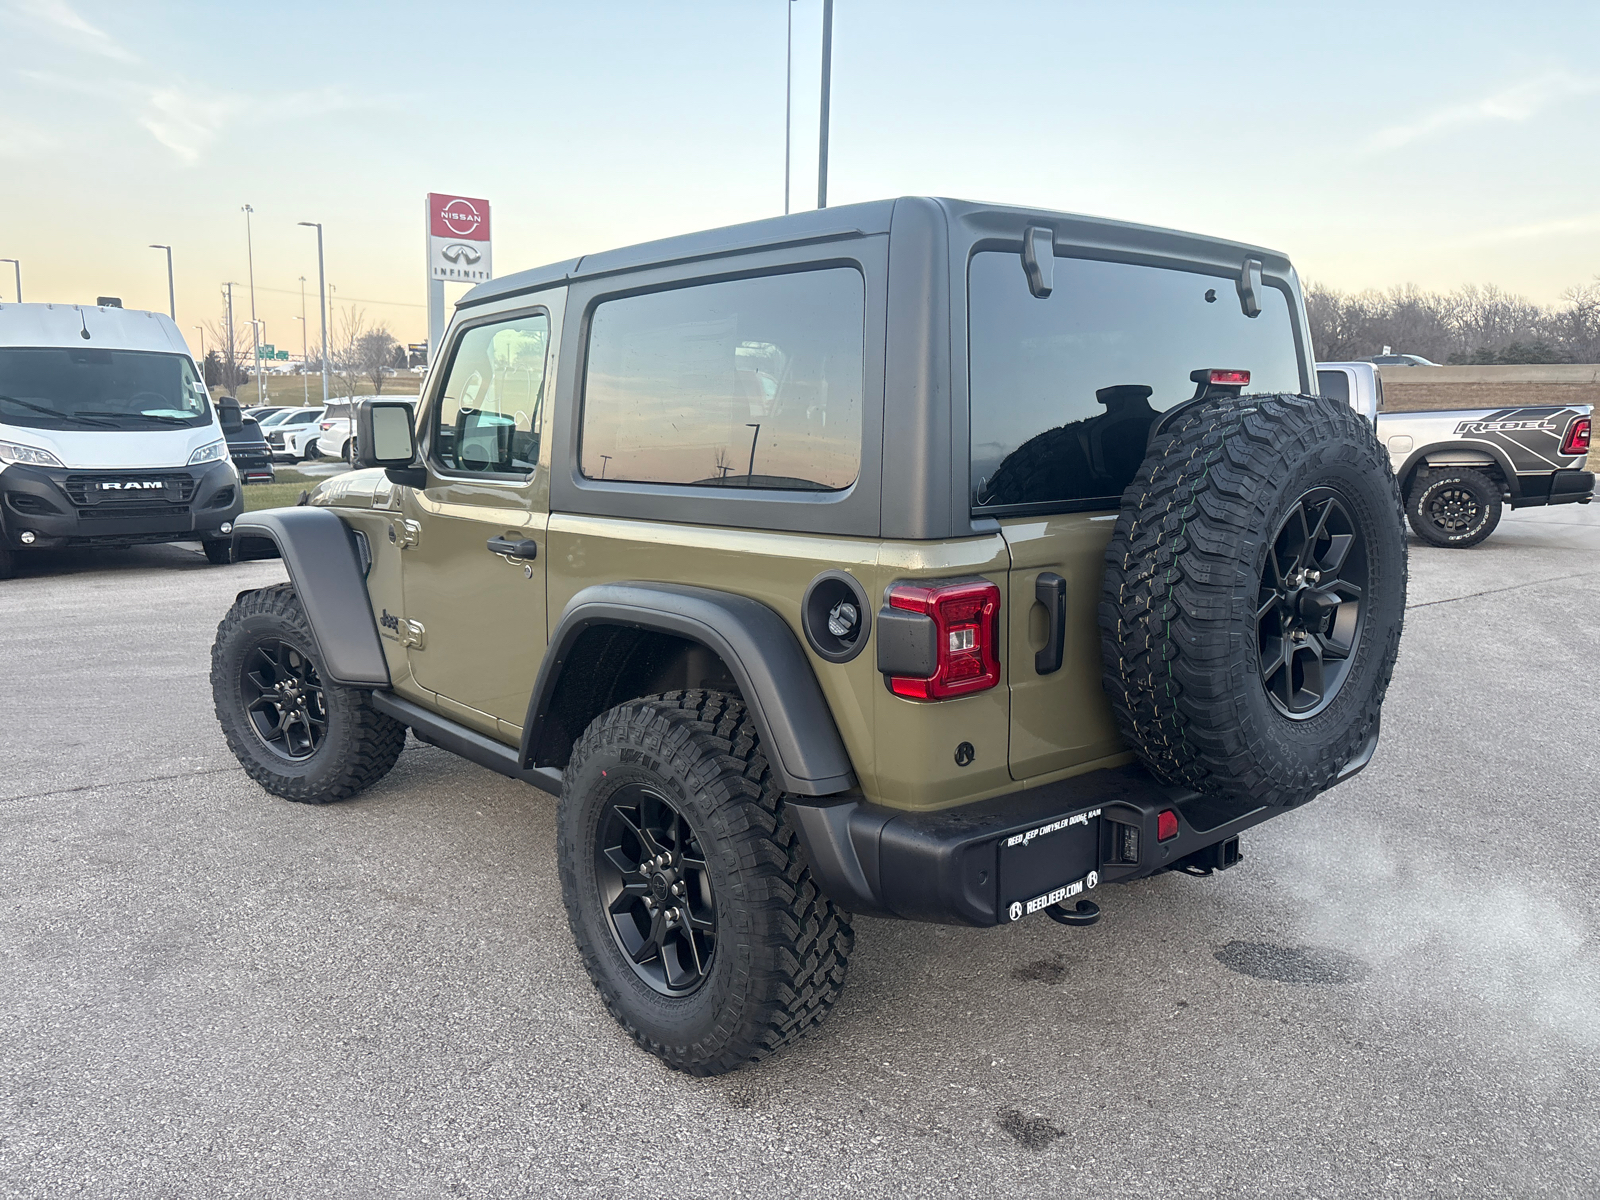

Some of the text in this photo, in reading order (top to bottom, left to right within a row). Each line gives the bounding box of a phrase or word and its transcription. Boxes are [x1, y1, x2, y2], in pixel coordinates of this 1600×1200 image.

[441, 211, 481, 222] NISSAN
[434, 267, 489, 280] INFINITI
[1453, 420, 1556, 434] REBEL
[102, 481, 163, 490] RAM
[1007, 808, 1101, 847] REED JEEP CHRYSLER DODGE RAM
[1026, 881, 1083, 914] REEDJEEP.COM
